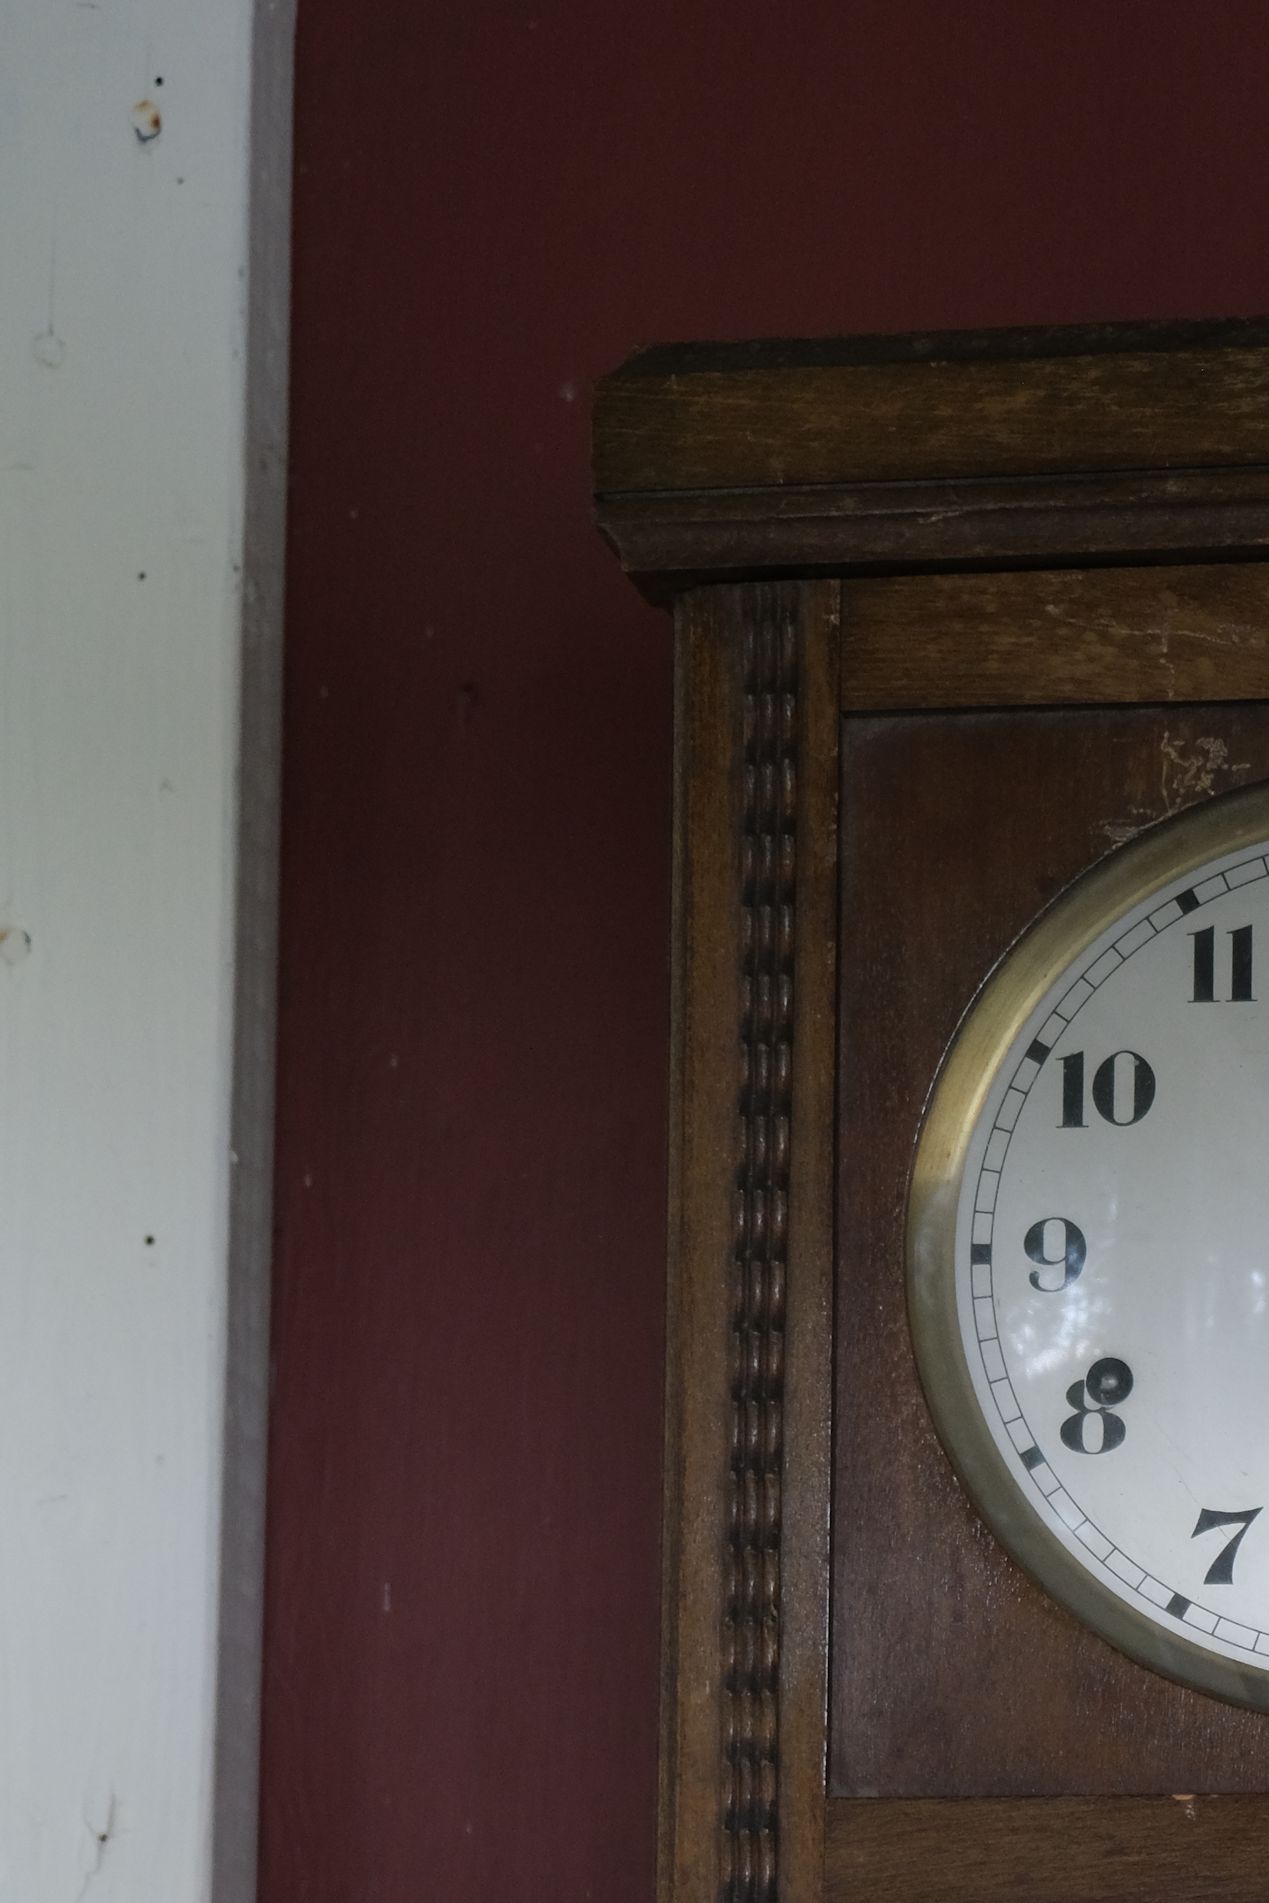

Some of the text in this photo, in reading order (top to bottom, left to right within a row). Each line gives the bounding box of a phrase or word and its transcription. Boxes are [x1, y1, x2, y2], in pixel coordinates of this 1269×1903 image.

[1187, 924, 1258, 1003] 11
[1054, 1050, 1156, 1129] 10
[1023, 1216, 1087, 1292] 9
[1060, 1378, 1126, 1455] 8
[1190, 1506, 1264, 1585] 7
